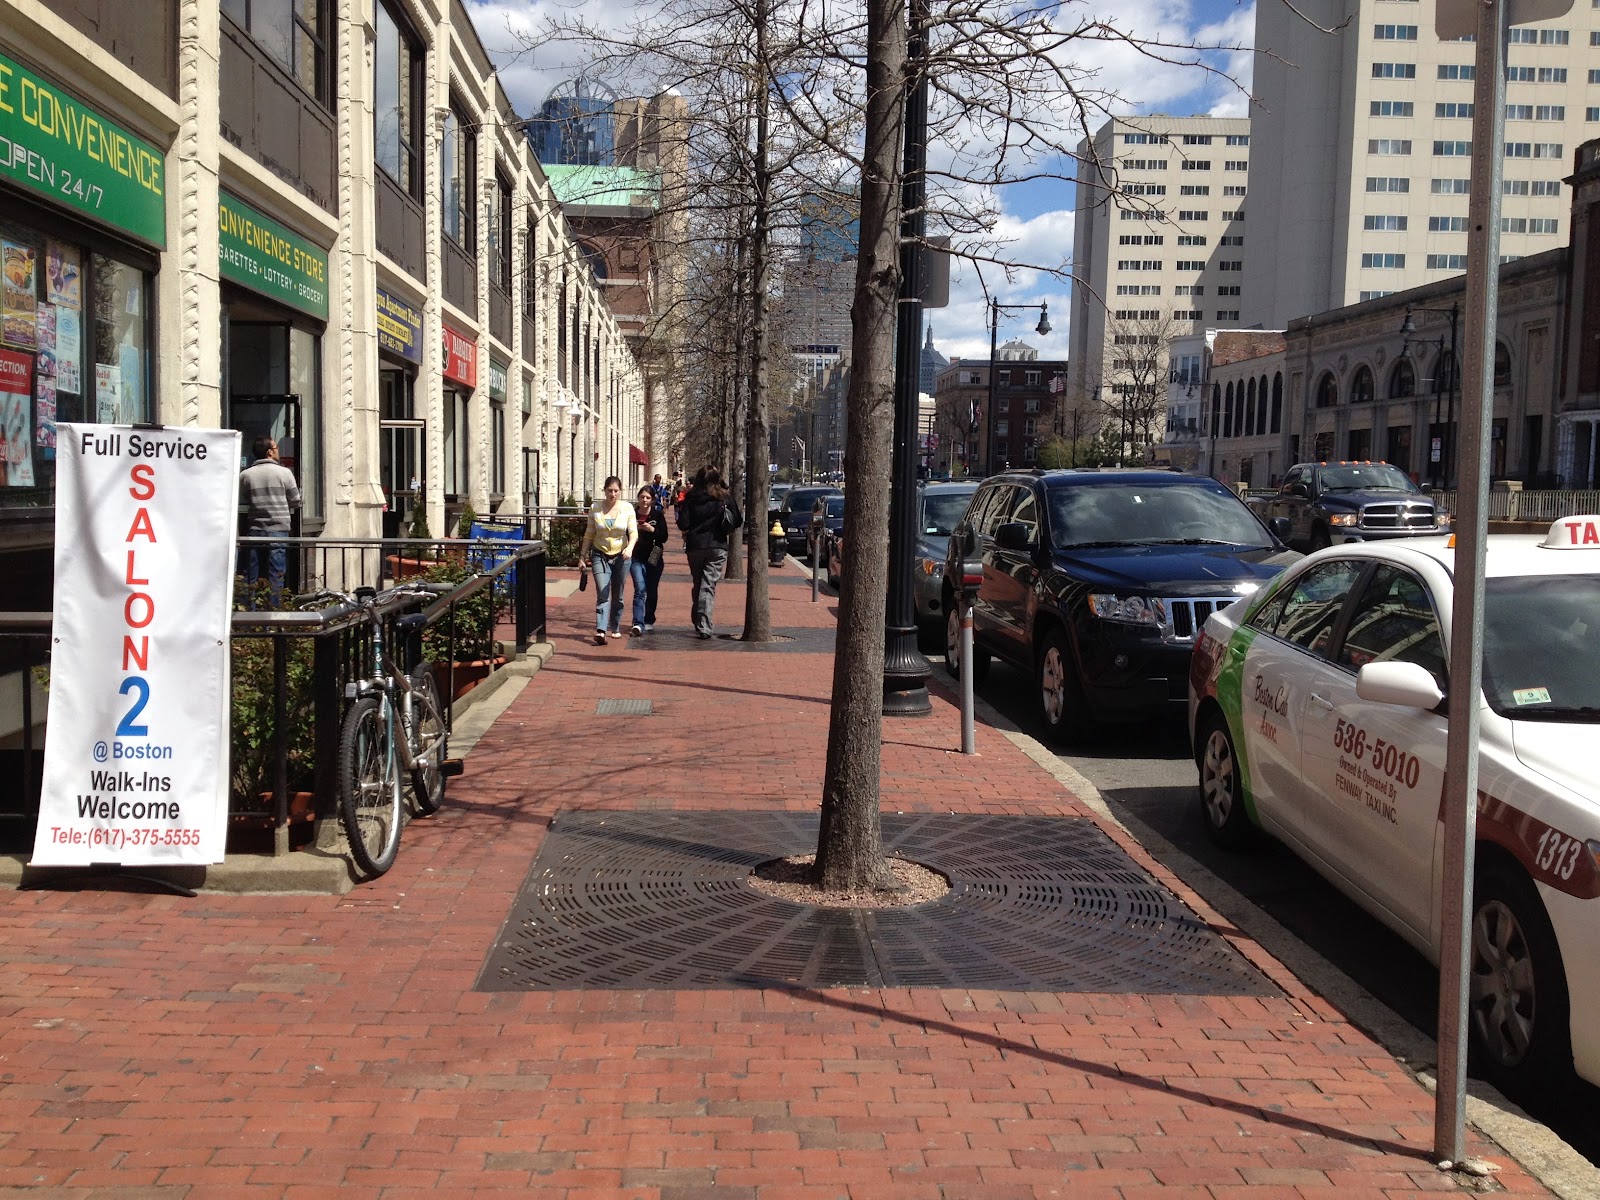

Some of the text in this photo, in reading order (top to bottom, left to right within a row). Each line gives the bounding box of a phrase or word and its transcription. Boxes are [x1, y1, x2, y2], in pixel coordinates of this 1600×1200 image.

[0, 63, 161, 196] E CONVENIENCE
[0, 135, 103, 208] OPEN 24/7
[219, 205, 324, 282] ONVENIENCE STORE
[218, 243, 324, 305] GARETTES LOTTERY GROCERY
[0, 360, 27, 376] ECTION.
[489, 367, 506, 394] RBUCKS
[81, 432, 207, 460] Full Service
[1564, 522, 1600, 545] TA
[1254, 675, 1288, 717] Boston Cab
[1334, 718, 1420, 789] 536-5010
[91, 770, 171, 792] Walk-Ins
[1335, 773, 1362, 802] FENWAY
[1339, 755, 1357, 778] Owned
[1362, 768, 1388, 795] Operated
[1388, 782, 1397, 804] By
[77, 795, 180, 819] Welcome
[1535, 828, 1581, 880] 1313
